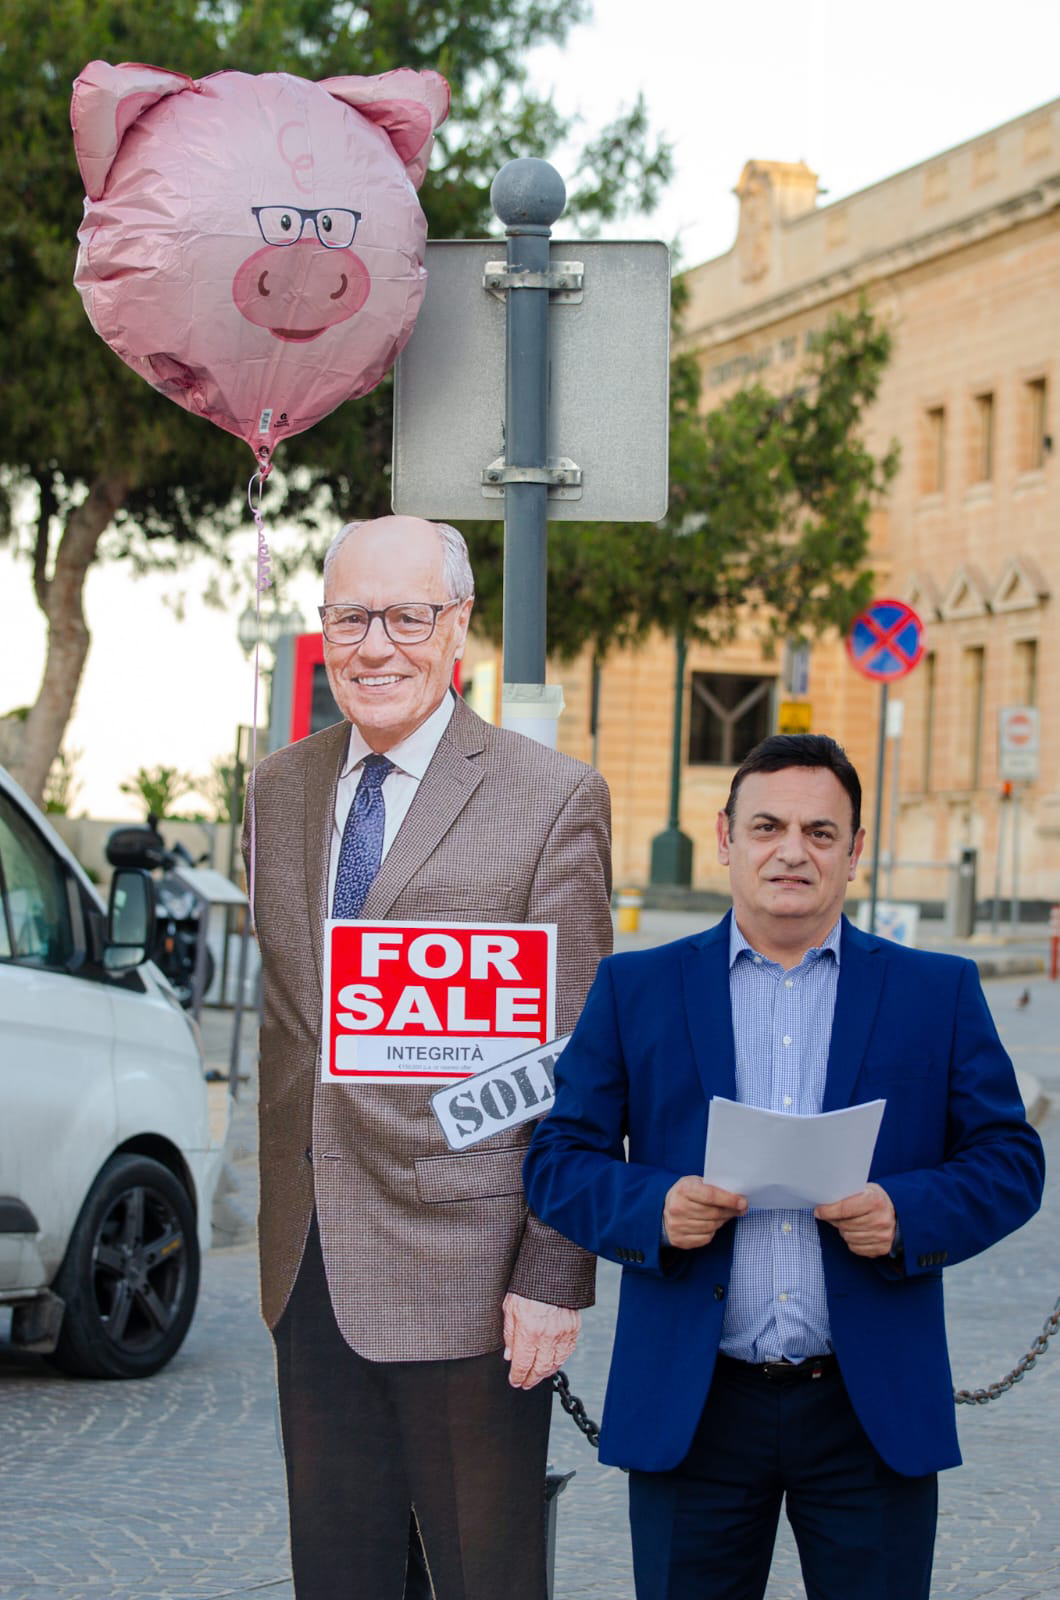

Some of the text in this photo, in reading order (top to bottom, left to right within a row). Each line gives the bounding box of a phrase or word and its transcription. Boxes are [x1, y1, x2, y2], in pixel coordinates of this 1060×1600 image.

[361, 933, 523, 980] FOR
[335, 984, 541, 1033] SALE
[387, 1044, 484, 1062] INTEGRITÀ
